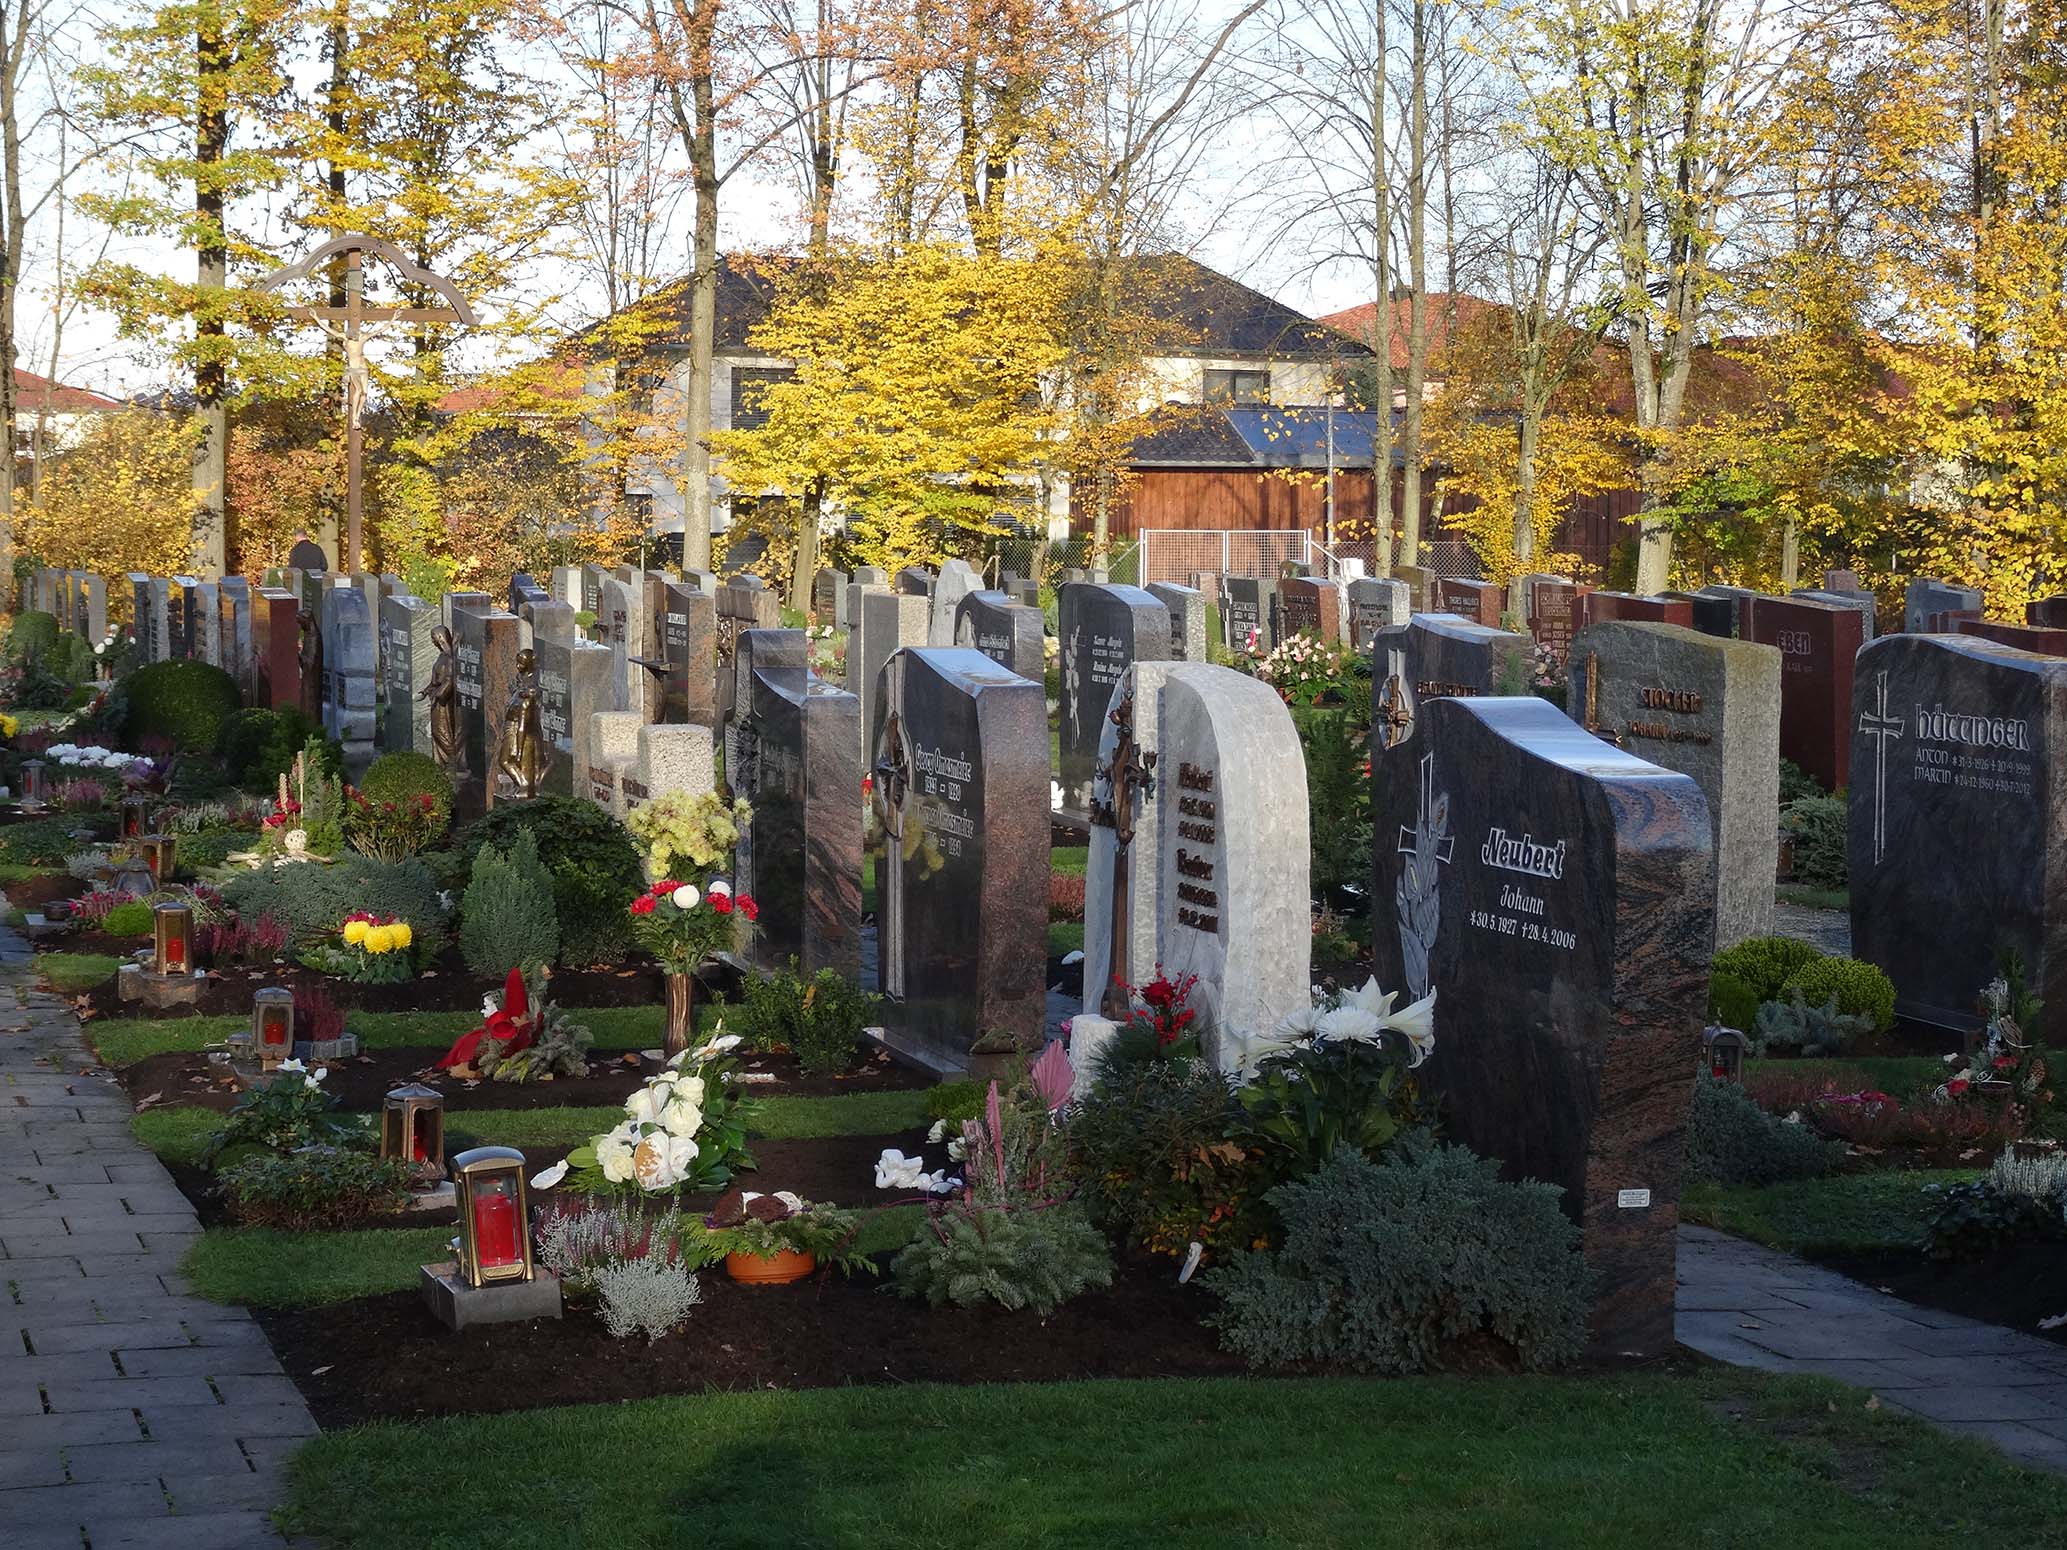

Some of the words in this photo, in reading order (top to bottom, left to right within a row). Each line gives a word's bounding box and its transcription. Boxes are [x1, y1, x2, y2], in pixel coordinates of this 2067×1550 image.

[1915, 747, 1949, 765] ANTON
[1914, 765, 1951, 784] MARTIN
[1481, 827, 1566, 880] Neubert
[1500, 884, 1544, 915] Johann
